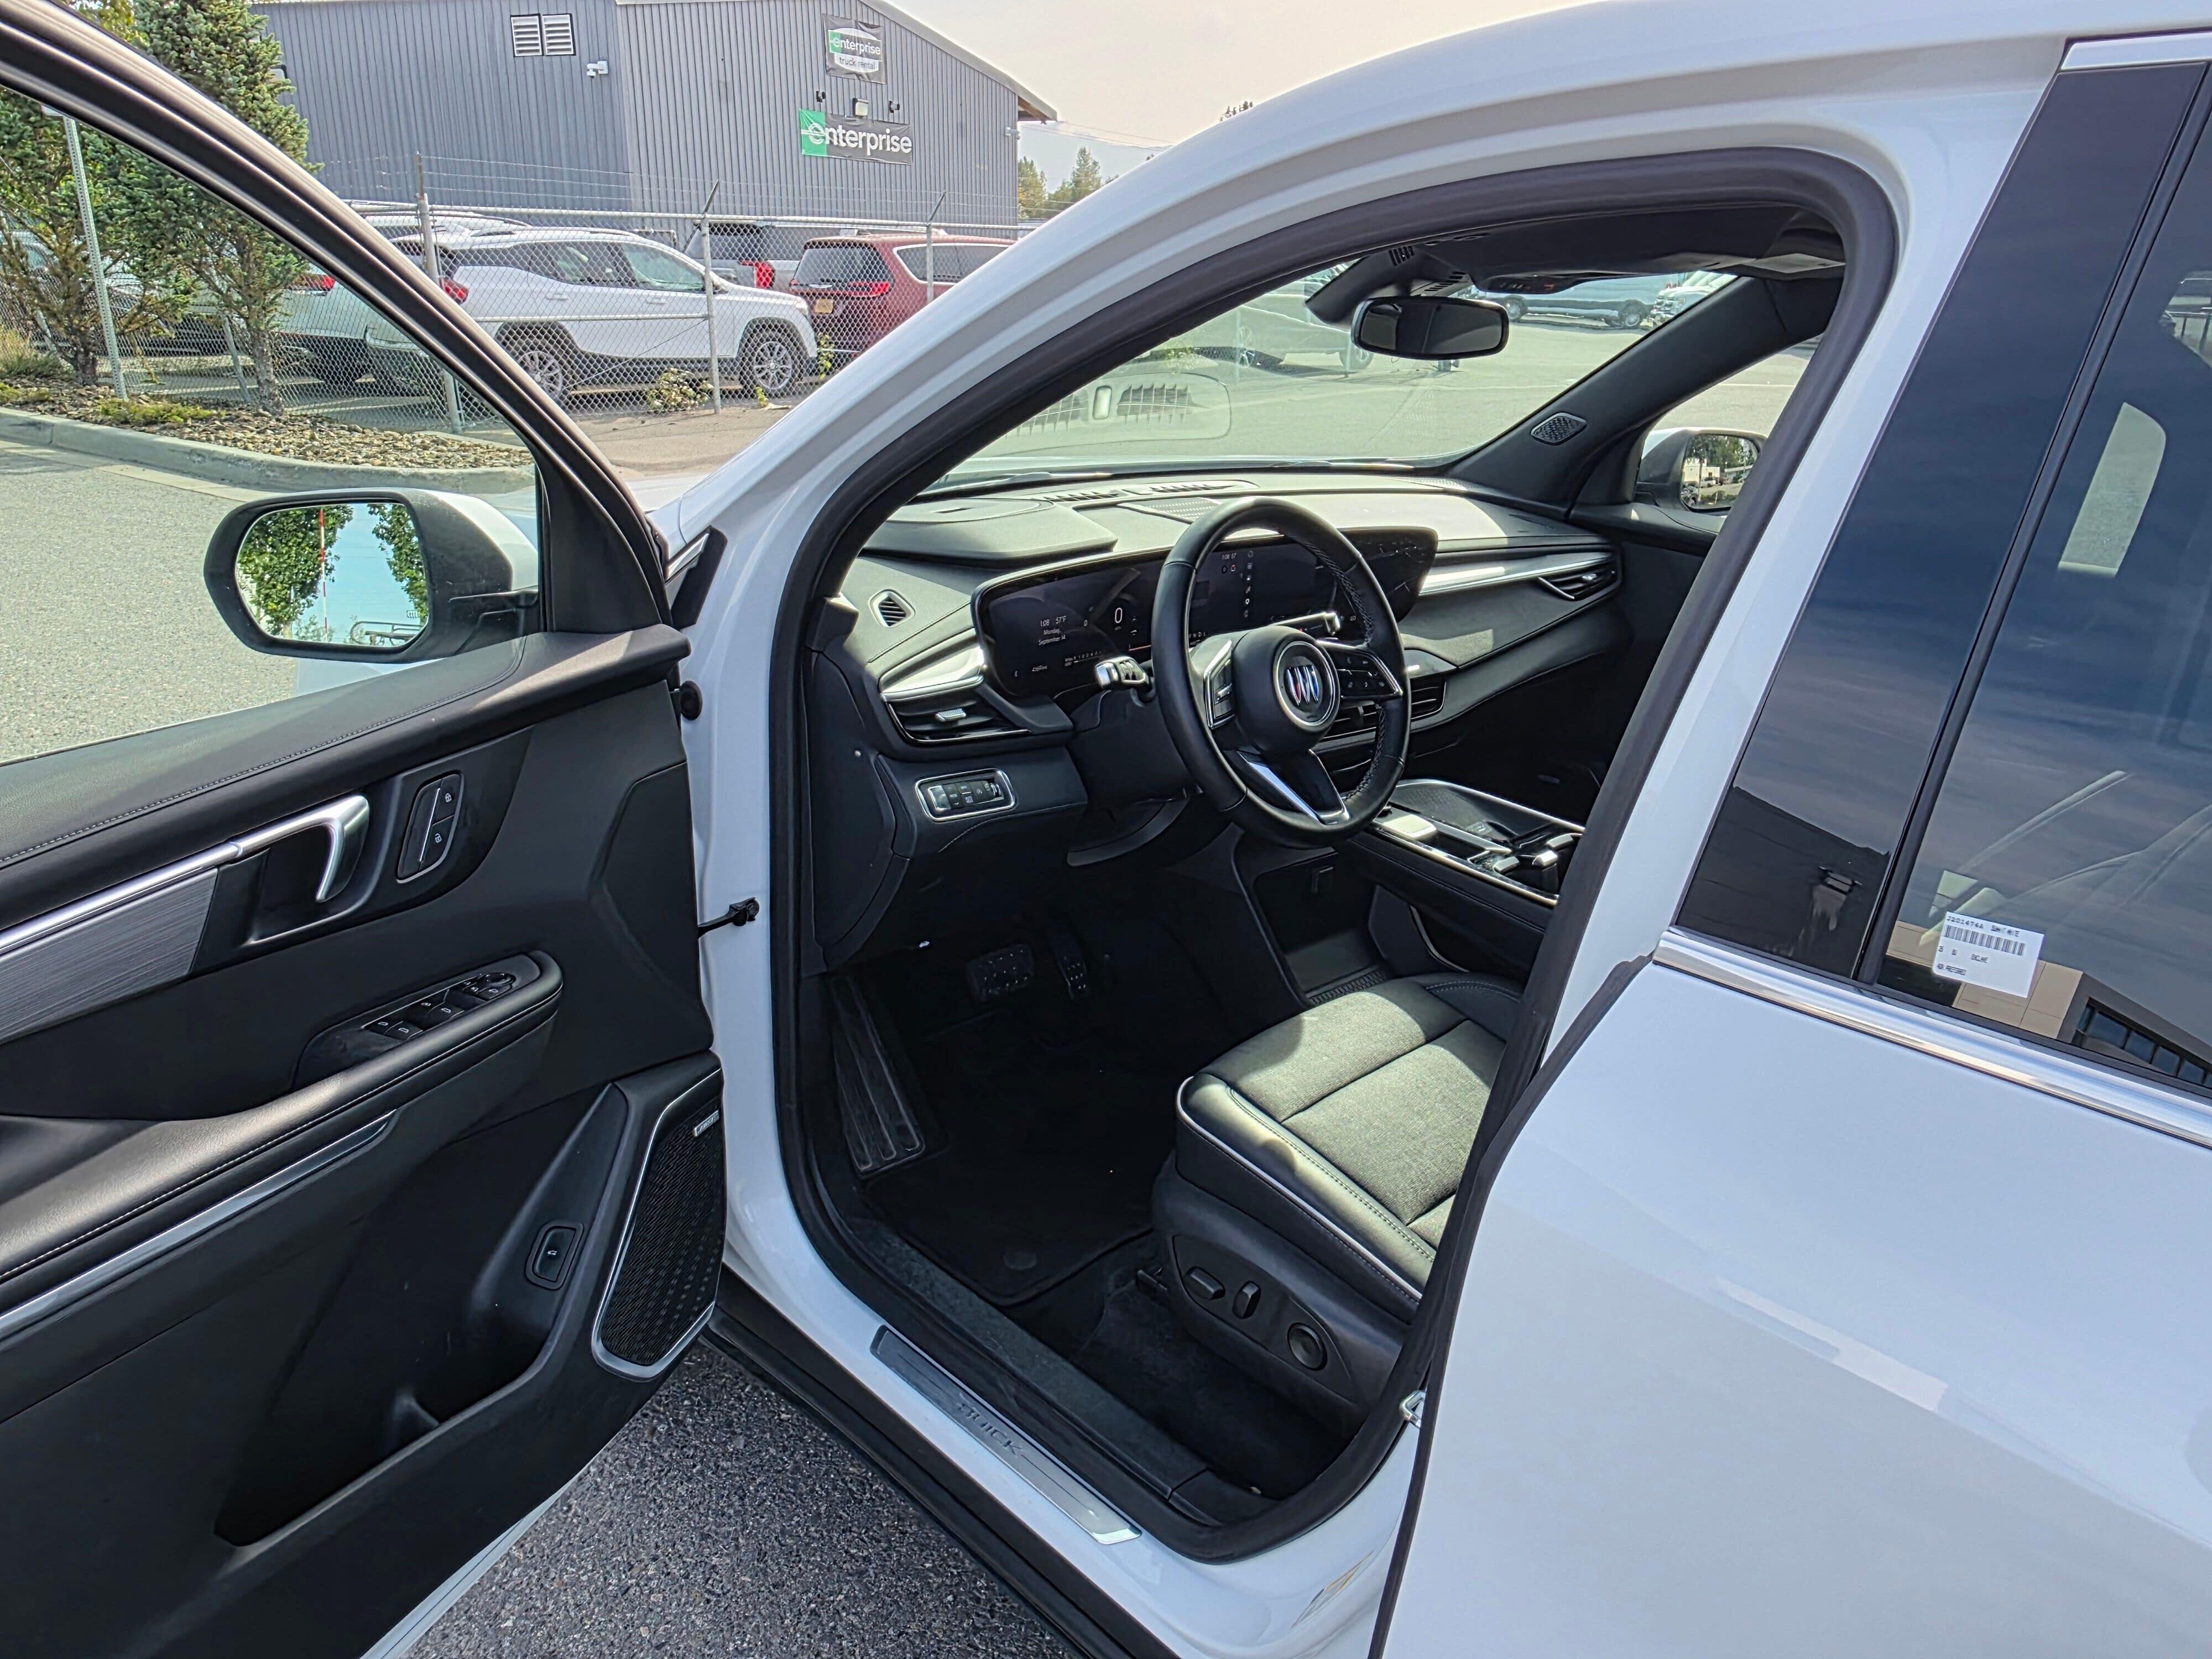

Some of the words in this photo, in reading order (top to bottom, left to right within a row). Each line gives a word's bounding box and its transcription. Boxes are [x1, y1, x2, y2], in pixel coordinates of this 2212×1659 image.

[832, 36, 881, 55] enterprise
[839, 57, 856, 66] truck
[858, 61, 875, 70] rental
[807, 122, 912, 155] enterprise
[1115, 607, 1123, 624] 0
